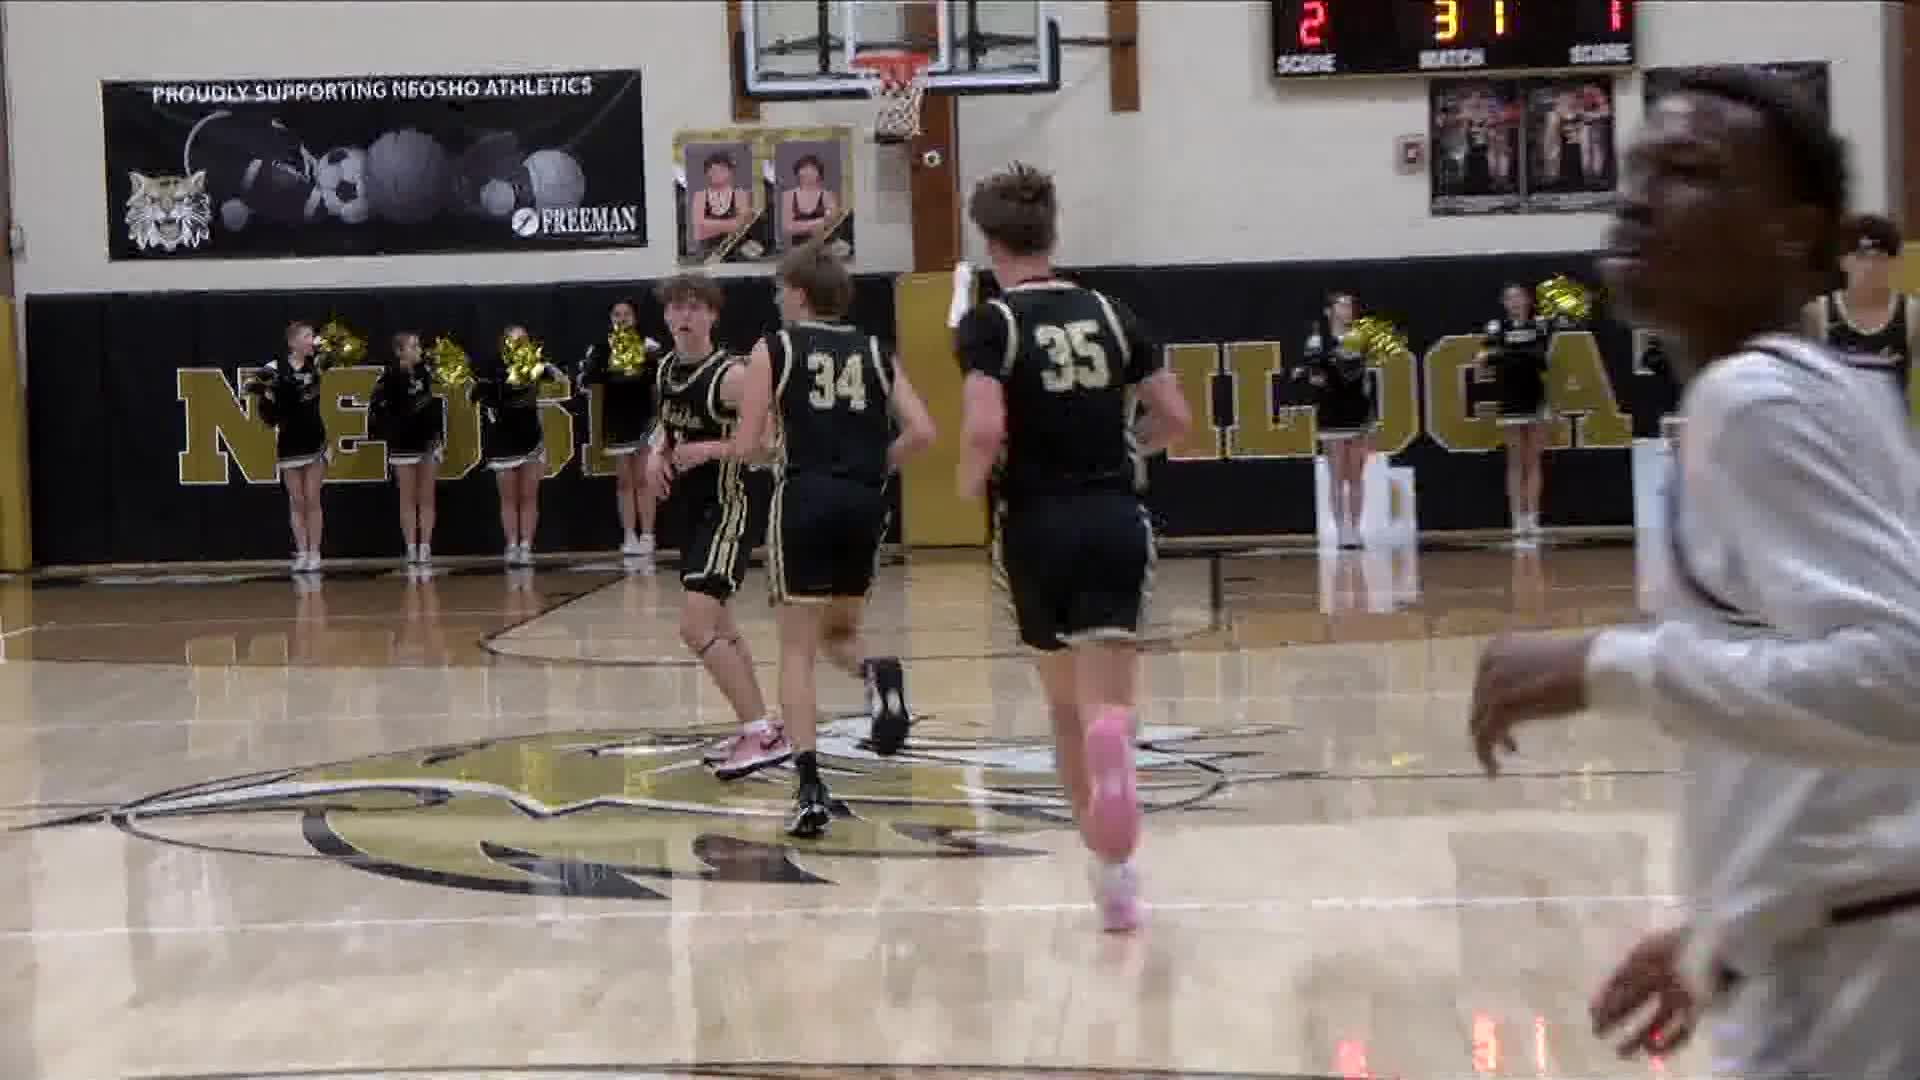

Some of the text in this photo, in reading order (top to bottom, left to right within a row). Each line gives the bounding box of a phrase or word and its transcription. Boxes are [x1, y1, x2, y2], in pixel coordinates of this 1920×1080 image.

[1299, 1, 1324, 45] 2
[152, 76, 593, 103] PROUDLY SUPPORTING NEOSHO ATHLETICS
[542, 206, 638, 234] FREEMAN
[1034, 319, 1112, 393] 35
[807, 352, 867, 411] 34
